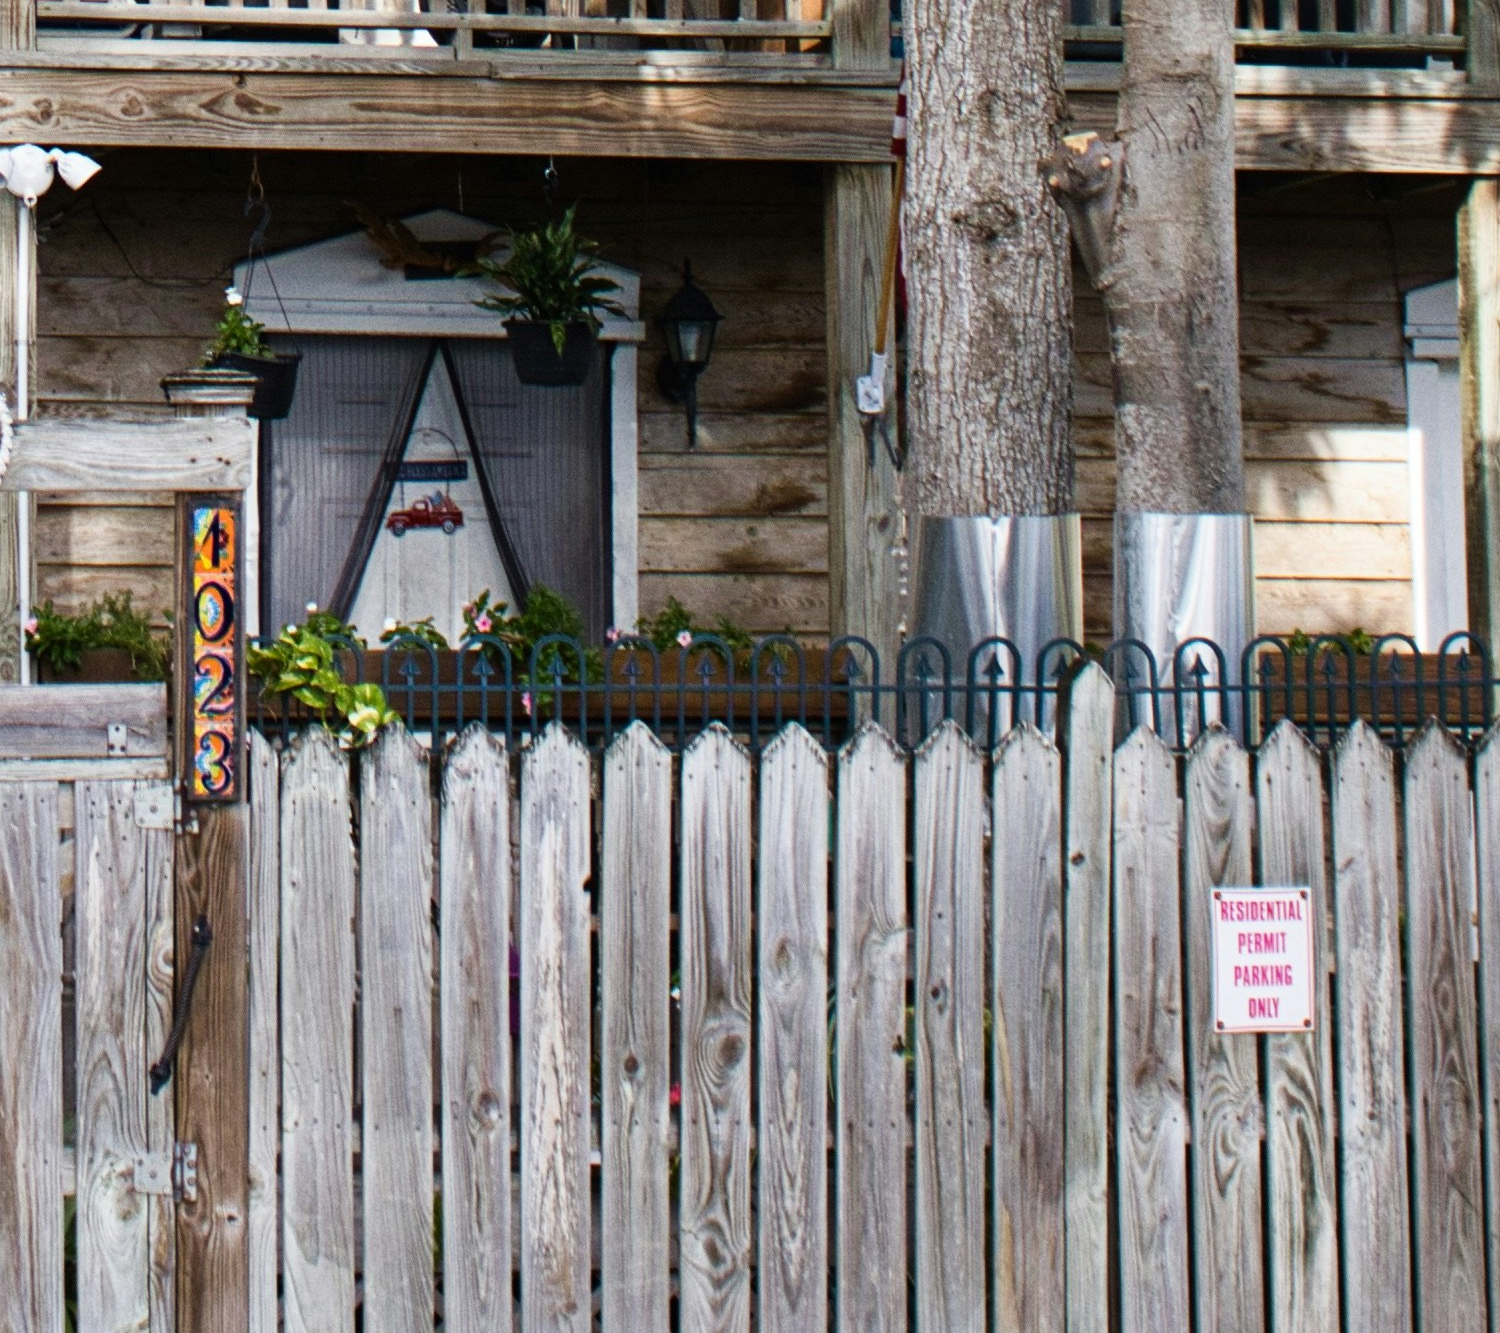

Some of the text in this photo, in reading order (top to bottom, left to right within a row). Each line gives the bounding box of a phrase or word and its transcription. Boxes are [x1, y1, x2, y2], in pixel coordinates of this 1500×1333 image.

[193, 509, 235, 794] 1023
[1220, 900, 1302, 921] RESIDENTIAL
[1237, 932, 1287, 954] PERMIT
[1234, 965, 1294, 987] PARKING
[1248, 998, 1280, 1018] ONLY
